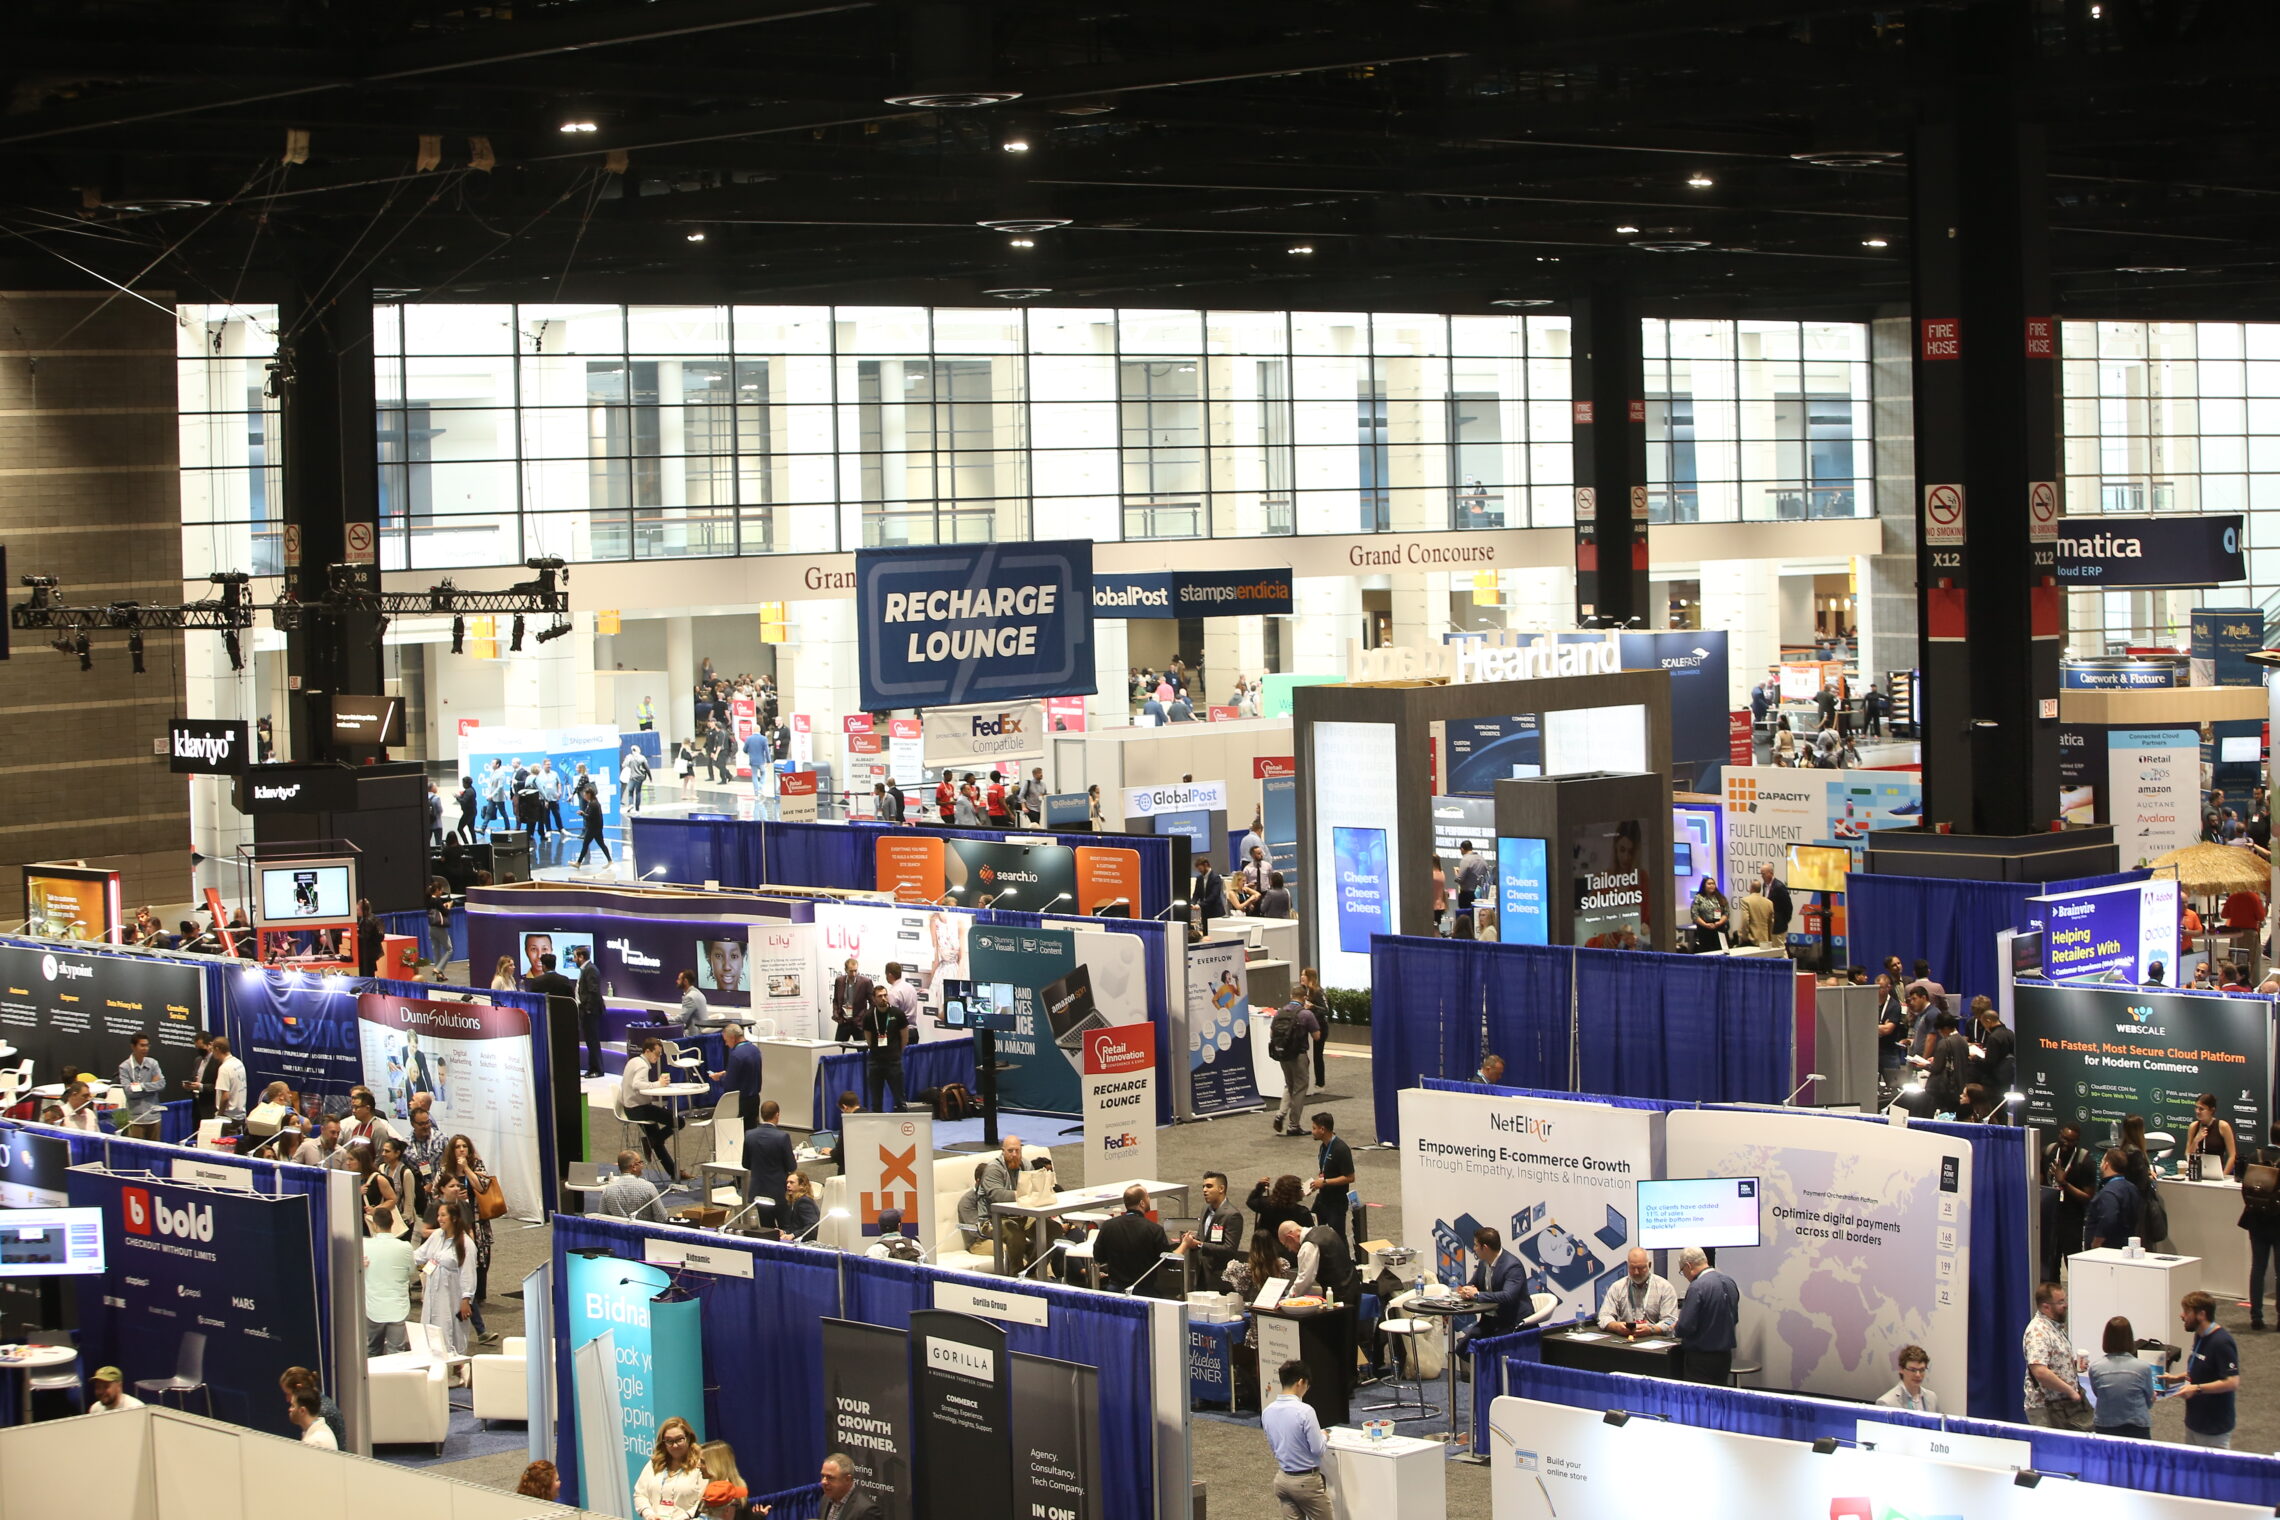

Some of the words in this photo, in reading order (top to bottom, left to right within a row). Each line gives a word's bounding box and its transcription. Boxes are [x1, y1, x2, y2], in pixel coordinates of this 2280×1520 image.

[1929, 324, 1954, 338] FIRE
[2029, 323, 2048, 336] FIRE
[1927, 341, 1957, 354] HOSE
[2028, 339, 2050, 353] HOSE
[1576, 404, 1591, 412] FIRE
[1576, 413, 1592, 421] HOSE
[2057, 532, 2142, 558] matica
[1350, 545, 1401, 566] Grand
[1407, 543, 1494, 564] Concourse
[1932, 553, 1960, 566] X12
[2034, 552, 2054, 565] X12
[354, 572, 368, 582] X8
[805, 566, 856, 590] Gran
[2058, 566, 2080, 576] loud
[2082, 566, 2103, 577] ERP
[1093, 586, 1168, 606] lobalPost
[1180, 584, 1234, 604] stamps
[1237, 580, 1288, 599] endicia
[884, 585, 1057, 623] RECHARGE
[908, 626, 1038, 662] LOUNGE
[1457, 628, 1622, 684] Heartland
[1661, 656, 1701, 668] SCALEFAST
[2080, 673, 2118, 684] Casework
[2120, 673, 2128, 684] &
[2130, 673, 2166, 684] Fixture
[2044, 700, 2056, 714] EXIT
[972, 713, 1022, 737] FedEx
[174, 729, 229, 765] klaviyo
[972, 736, 1024, 754] Compatible
[2147, 755, 2170, 764] Retail
[255, 785, 296, 800] klaviyo
[1153, 788, 1217, 806] GlobalPost
[1758, 792, 1810, 802] CAPACITY
[2138, 786, 2172, 794] amazon
[2136, 814, 2176, 824] Avalara
[1730, 824, 1802, 840] FULFILLMENT
[1730, 860, 1744, 873] TO
[997, 870, 1038, 883] search.io
[1344, 870, 1379, 884] Cheers
[1506, 876, 1538, 888] Cheers
[1584, 868, 1638, 890] Tailored
[1345, 886, 1380, 900] Cheers
[1506, 889, 1539, 901] Cheers
[1580, 889, 1643, 910] solutions
[2156, 892, 2173, 902] Adobe
[1346, 902, 1381, 914] Cheers
[1507, 902, 1540, 914] Cheers
[2058, 902, 2096, 918] Brainvire
[768, 934, 790, 948] Lily
[826, 924, 861, 959] Lily
[2052, 928, 2091, 946] Helping
[994, 944, 1015, 952] Visuals
[1040, 946, 1062, 955] Content
[2052, 946, 2095, 964] Retailers
[2096, 940, 2120, 956] With
[1197, 954, 1232, 965] EVERFLOW
[58, 964, 94, 980] skypoint
[1052, 993, 1076, 1014] amazon
[400, 1006, 481, 1030] DunnSolutions
[2116, 1024, 2166, 1036] WEBSCALE
[1004, 1042, 1036, 1056] AMAZON
[1102, 1042, 1126, 1056] Retail
[2040, 1038, 2058, 1049] The
[2060, 1040, 2100, 1054] Fastest,
[2102, 1043, 2126, 1054] Most
[2130, 1046, 2164, 1058] Secure
[2167, 1048, 2198, 1060] Cloud
[2200, 1050, 2246, 1064] Platform
[1106, 1051, 1145, 1063] Innovation
[2084, 1055, 2098, 1066] for
[2102, 1057, 2141, 1069] Modern
[2143, 1060, 2199, 1074] Commerce
[1093, 1079, 1148, 1096] RECHARGE
[2090, 1084, 2117, 1092] CloudEDGE
[1100, 1095, 1141, 1110] LOUNGE
[1104, 1132, 1138, 1150] FedEx
[1104, 1147, 1139, 1160] Compatible
[1418, 1138, 1496, 1162] Empowering
[1500, 1147, 1579, 1168] E-commerce
[1582, 1156, 1631, 1174] Growth
[1418, 1155, 1464, 1174] Through
[1466, 1163, 1516, 1180] Empathy,
[1517, 1166, 1560, 1184] Insights
[1562, 1173, 1570, 1184] &
[1573, 1174, 1632, 1190] Innovation
[1802, 1190, 1826, 1198] Payment
[1826, 1192, 1860, 1202] Orchestration
[1944, 1203, 1952, 1212] 28
[154, 1196, 214, 1242] bold
[1772, 1206, 1820, 1221] Optimize
[1823, 1212, 1854, 1226] digital
[1856, 1216, 1901, 1233] payments
[1795, 1226, 1830, 1238] across
[1832, 1229, 1844, 1240] all
[1846, 1230, 1882, 1246] borders
[1942, 1232, 1952, 1242] 168
[125, 1237, 160, 1251] CHECKOUT
[162, 1244, 193, 1258] WITHOUT
[194, 1250, 217, 1262] LIMITS
[686, 1252, 711, 1264] Bidnamic
[1940, 1261, 1952, 1270] 199
[1941, 1290, 1949, 1300] 22
[232, 1296, 256, 1310] MARS
[586, 1292, 650, 1328] Bidna
[972, 1296, 990, 1309] Gorilla
[990, 1300, 1008, 1312] Group
[933, 1348, 988, 1370] GORILLA
[1190, 1366, 1222, 1384] RNER
[836, 1396, 870, 1415] YOUR
[946, 1394, 978, 1408] COMMERCE
[837, 1414, 892, 1436] GROWTH
[838, 1430, 897, 1454] PARTNER.
[1930, 1442, 1950, 1455] Zoho
[1030, 1448, 1058, 1462] Agency.
[1546, 1456, 1564, 1467] Build
[1565, 1461, 1582, 1470] your
[1030, 1462, 1076, 1480] Consultancy.
[1546, 1468, 1568, 1478] online
[1570, 1472, 1588, 1482] store
[860, 1480, 895, 1492] outcomes
[1030, 1476, 1048, 1486] Tech
[1048, 1480, 1085, 1496] Company.
[1032, 1503, 1046, 1518] IN
[1048, 1506, 1076, 1520] ONE
